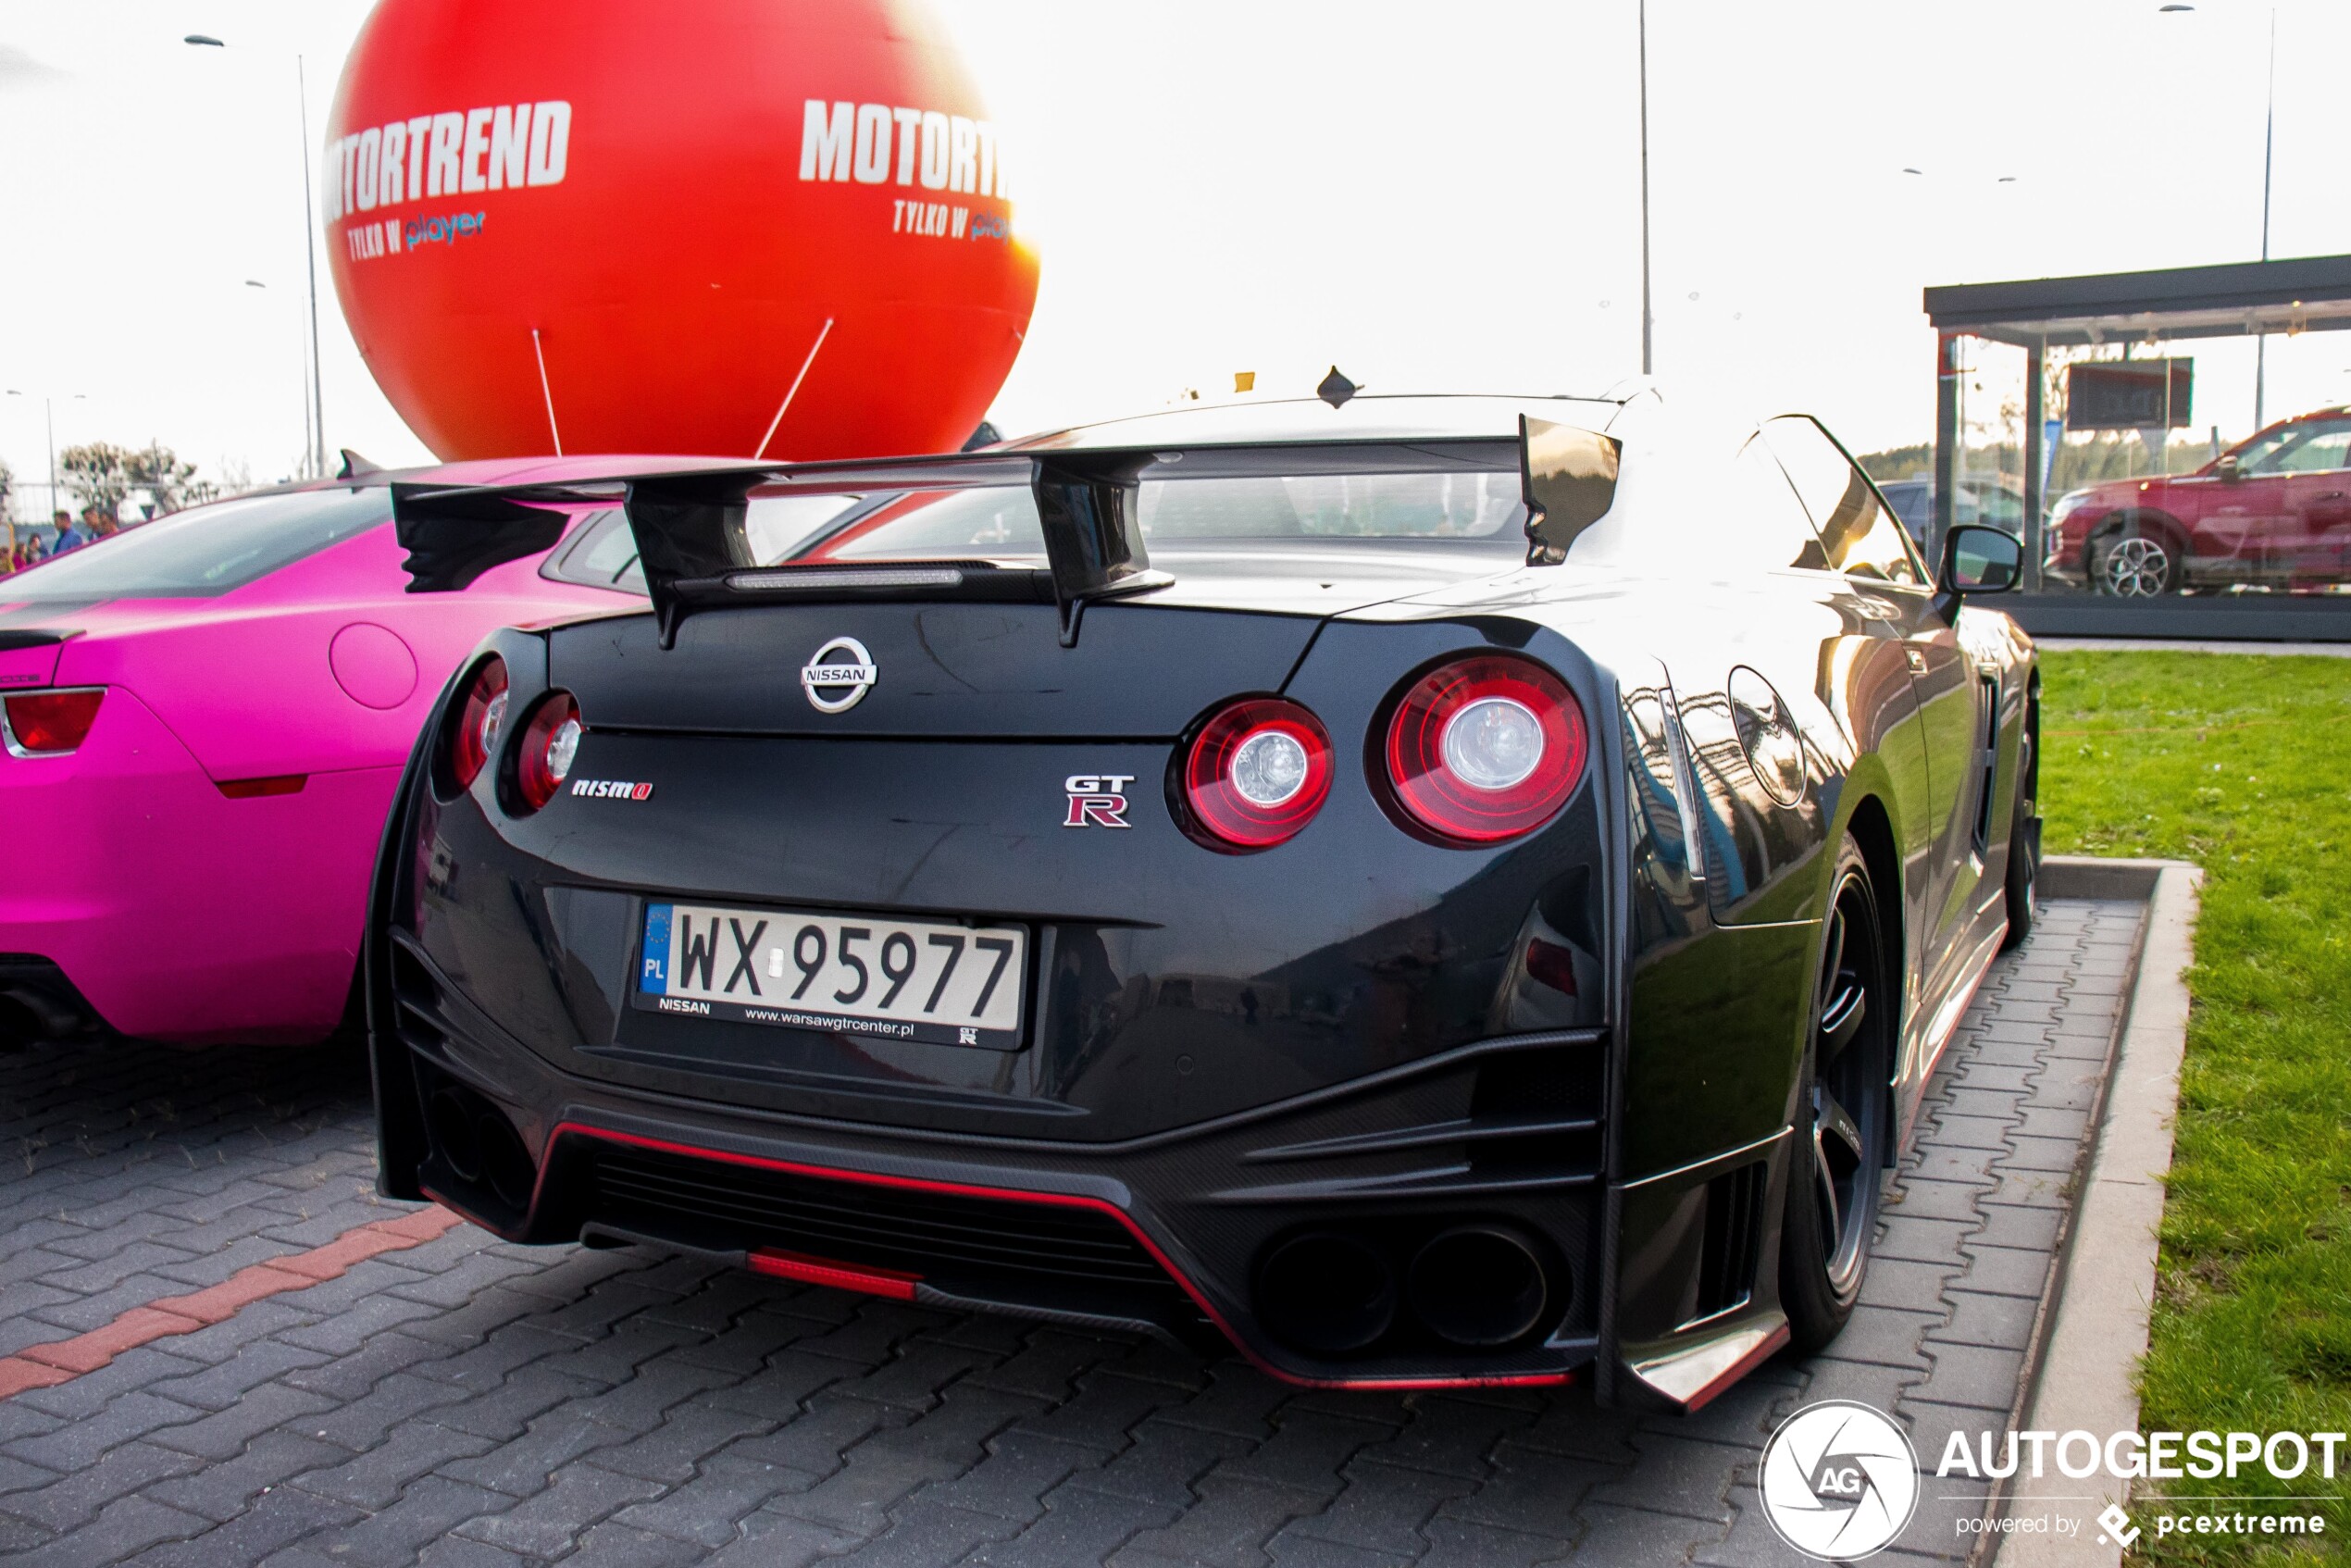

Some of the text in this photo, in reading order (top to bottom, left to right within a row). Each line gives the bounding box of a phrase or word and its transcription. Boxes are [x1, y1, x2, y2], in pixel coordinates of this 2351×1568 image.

[324, 100, 572, 225] OTORTREND
[347, 210, 487, 262] TYLKO W player
[893, 200, 949, 238] TYLKO
[951, 205, 969, 239] W
[805, 668, 866, 681] NISSAN
[1064, 775, 1135, 793] GT
[1063, 793, 1131, 828] R
[645, 959, 665, 980] PL
[679, 915, 1014, 1018] WX 95977
[659, 998, 914, 1037] NISSAN www.warsawgtrcenter.pl
